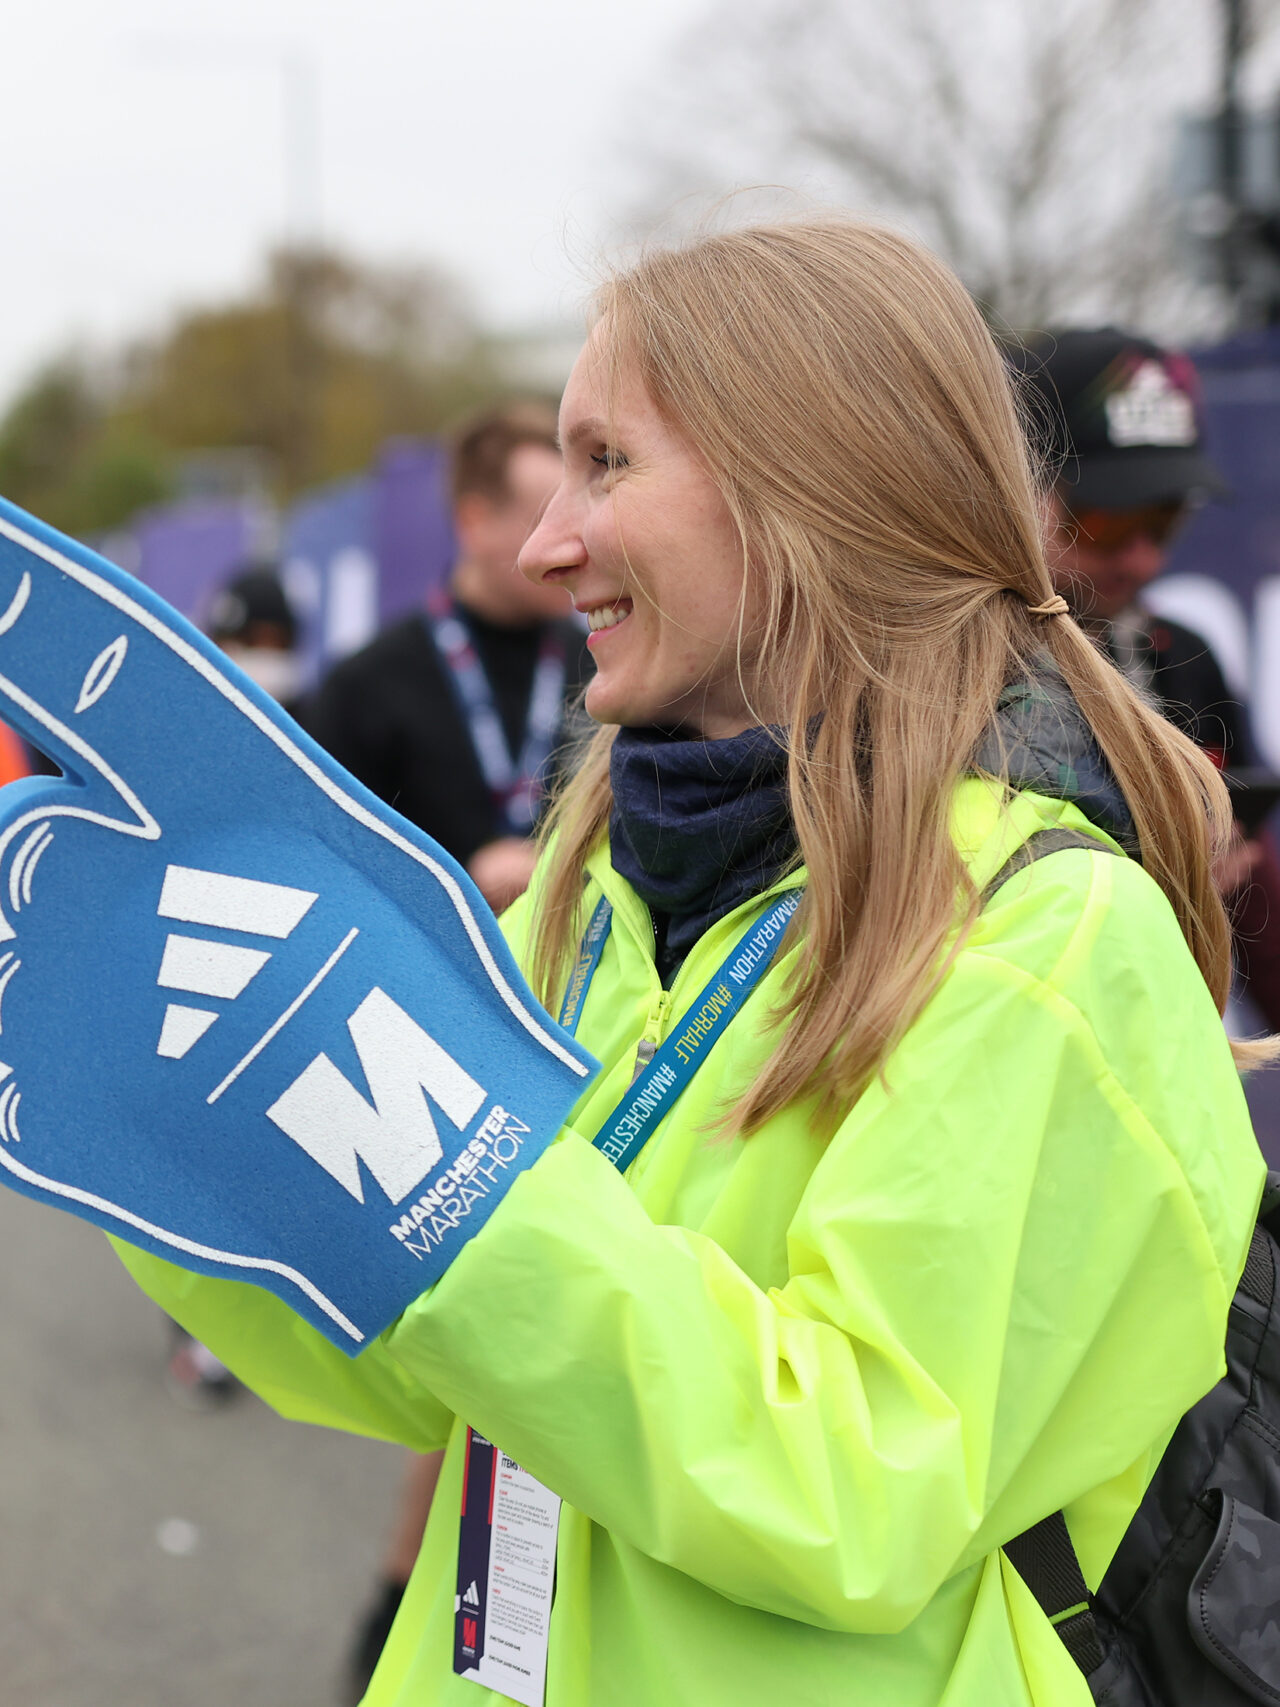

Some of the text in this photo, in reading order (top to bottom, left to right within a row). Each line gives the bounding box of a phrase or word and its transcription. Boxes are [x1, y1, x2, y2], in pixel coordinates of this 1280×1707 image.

[265, 985, 488, 1206] M
[674, 983, 733, 1065] #MCRHALF
[389, 1104, 511, 1242] MANCHESTER
[403, 1112, 531, 1261] MARATHON
